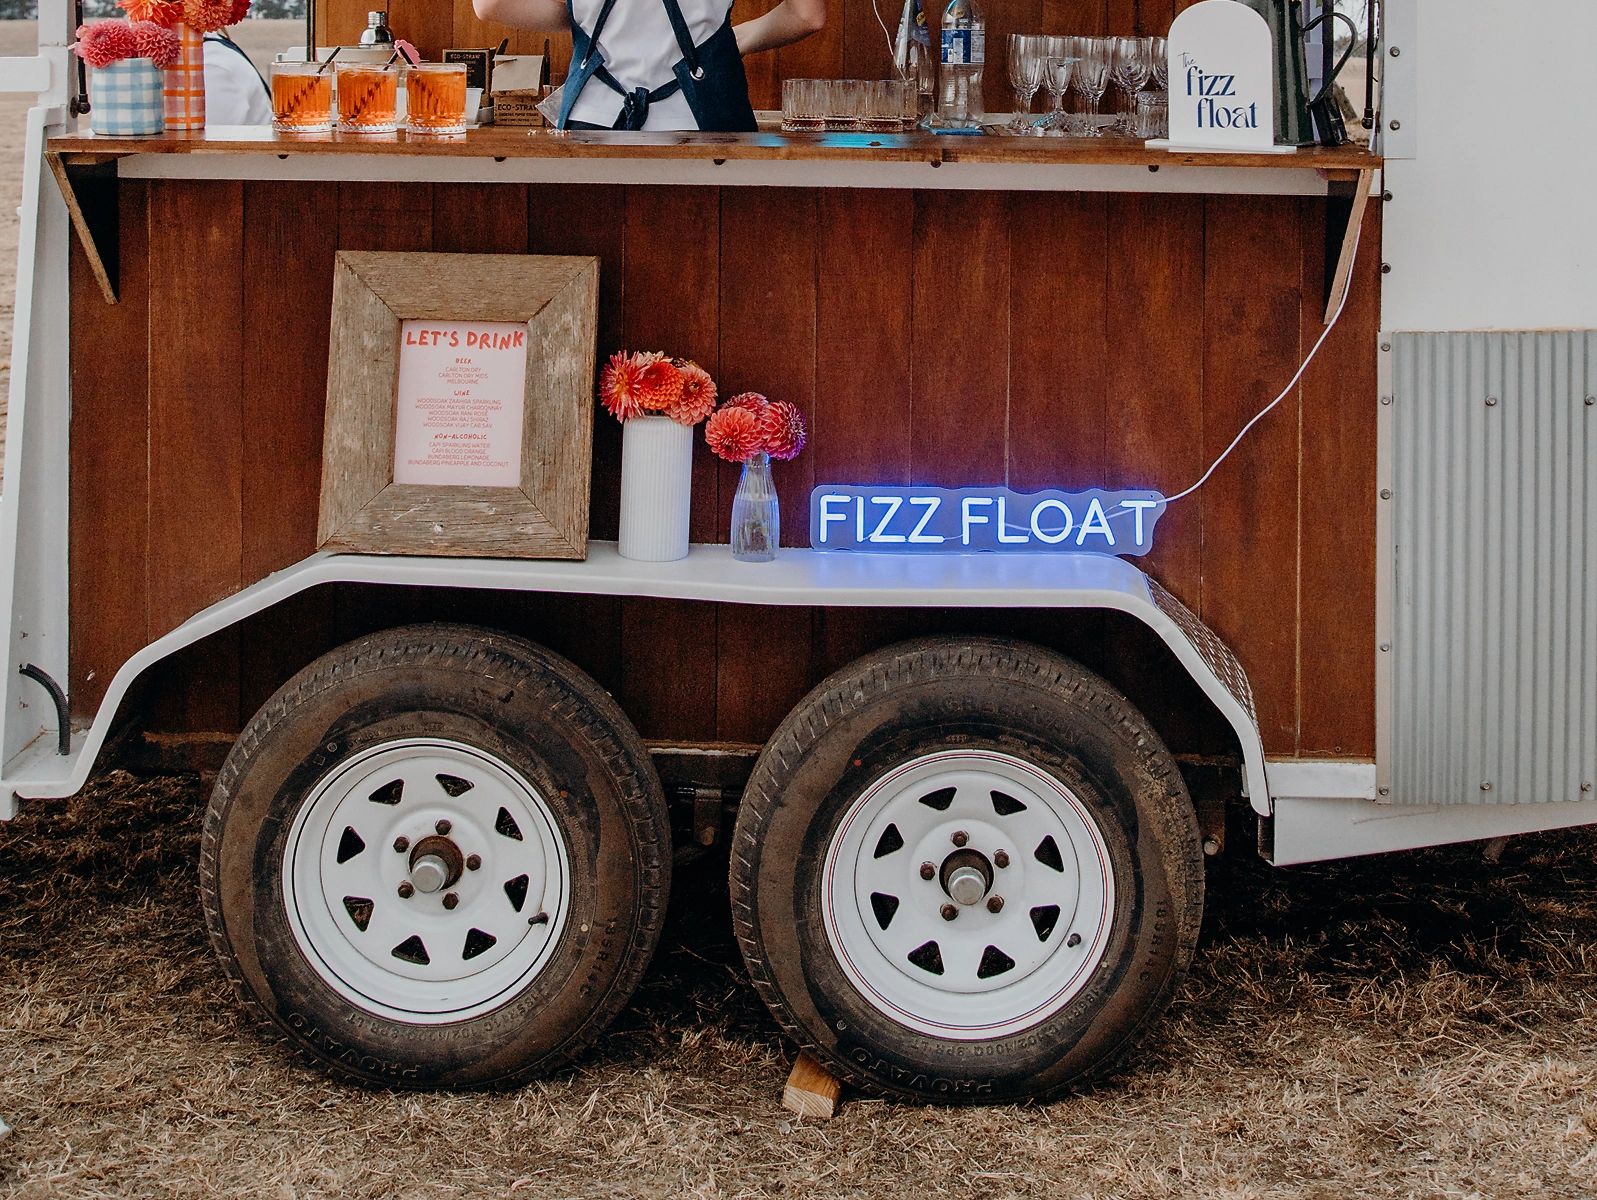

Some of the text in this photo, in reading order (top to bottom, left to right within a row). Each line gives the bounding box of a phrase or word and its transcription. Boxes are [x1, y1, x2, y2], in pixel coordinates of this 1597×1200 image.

[1187, 66, 1236, 96] fizz
[1198, 98, 1258, 128] float
[406, 330, 524, 350] LET'S DRINK
[819, 494, 1157, 546] FIZZ FLOAT
[848, 1046, 992, 1094] PROVATO
